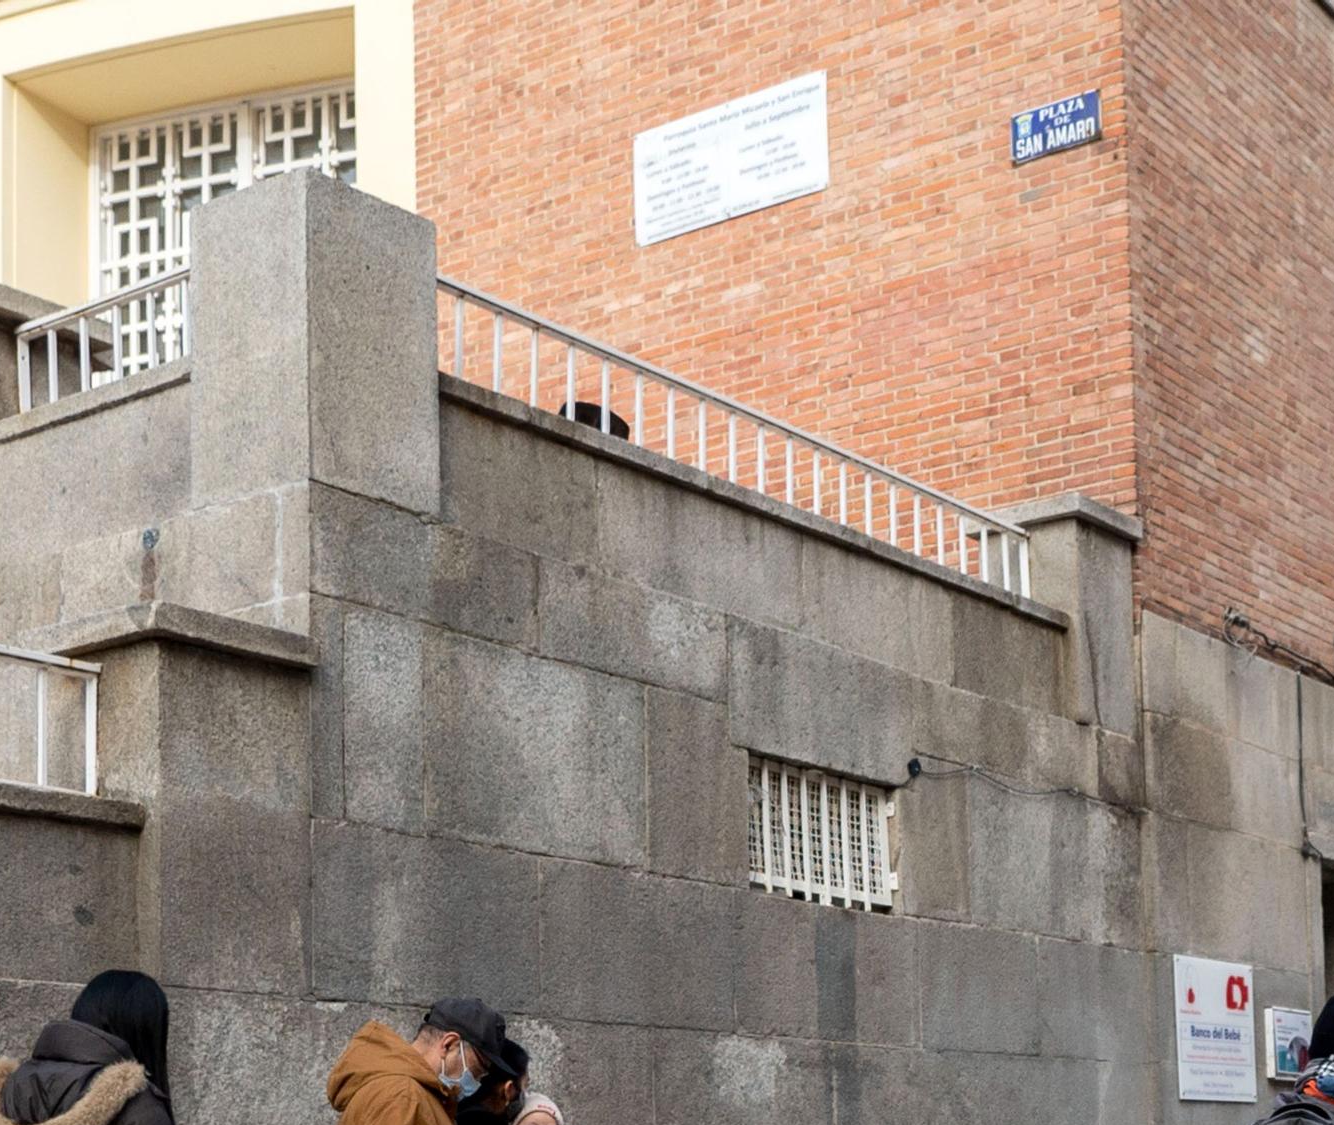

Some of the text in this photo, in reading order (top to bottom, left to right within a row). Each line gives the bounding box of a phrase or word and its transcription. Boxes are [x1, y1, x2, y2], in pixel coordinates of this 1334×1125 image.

[1039, 98, 1084, 121] PLAZA
[1054, 115, 1072, 126] DE
[1015, 132, 1044, 159] SAN
[1191, 1025, 1211, 1038] Banco
[1212, 1026, 1223, 1039] del
